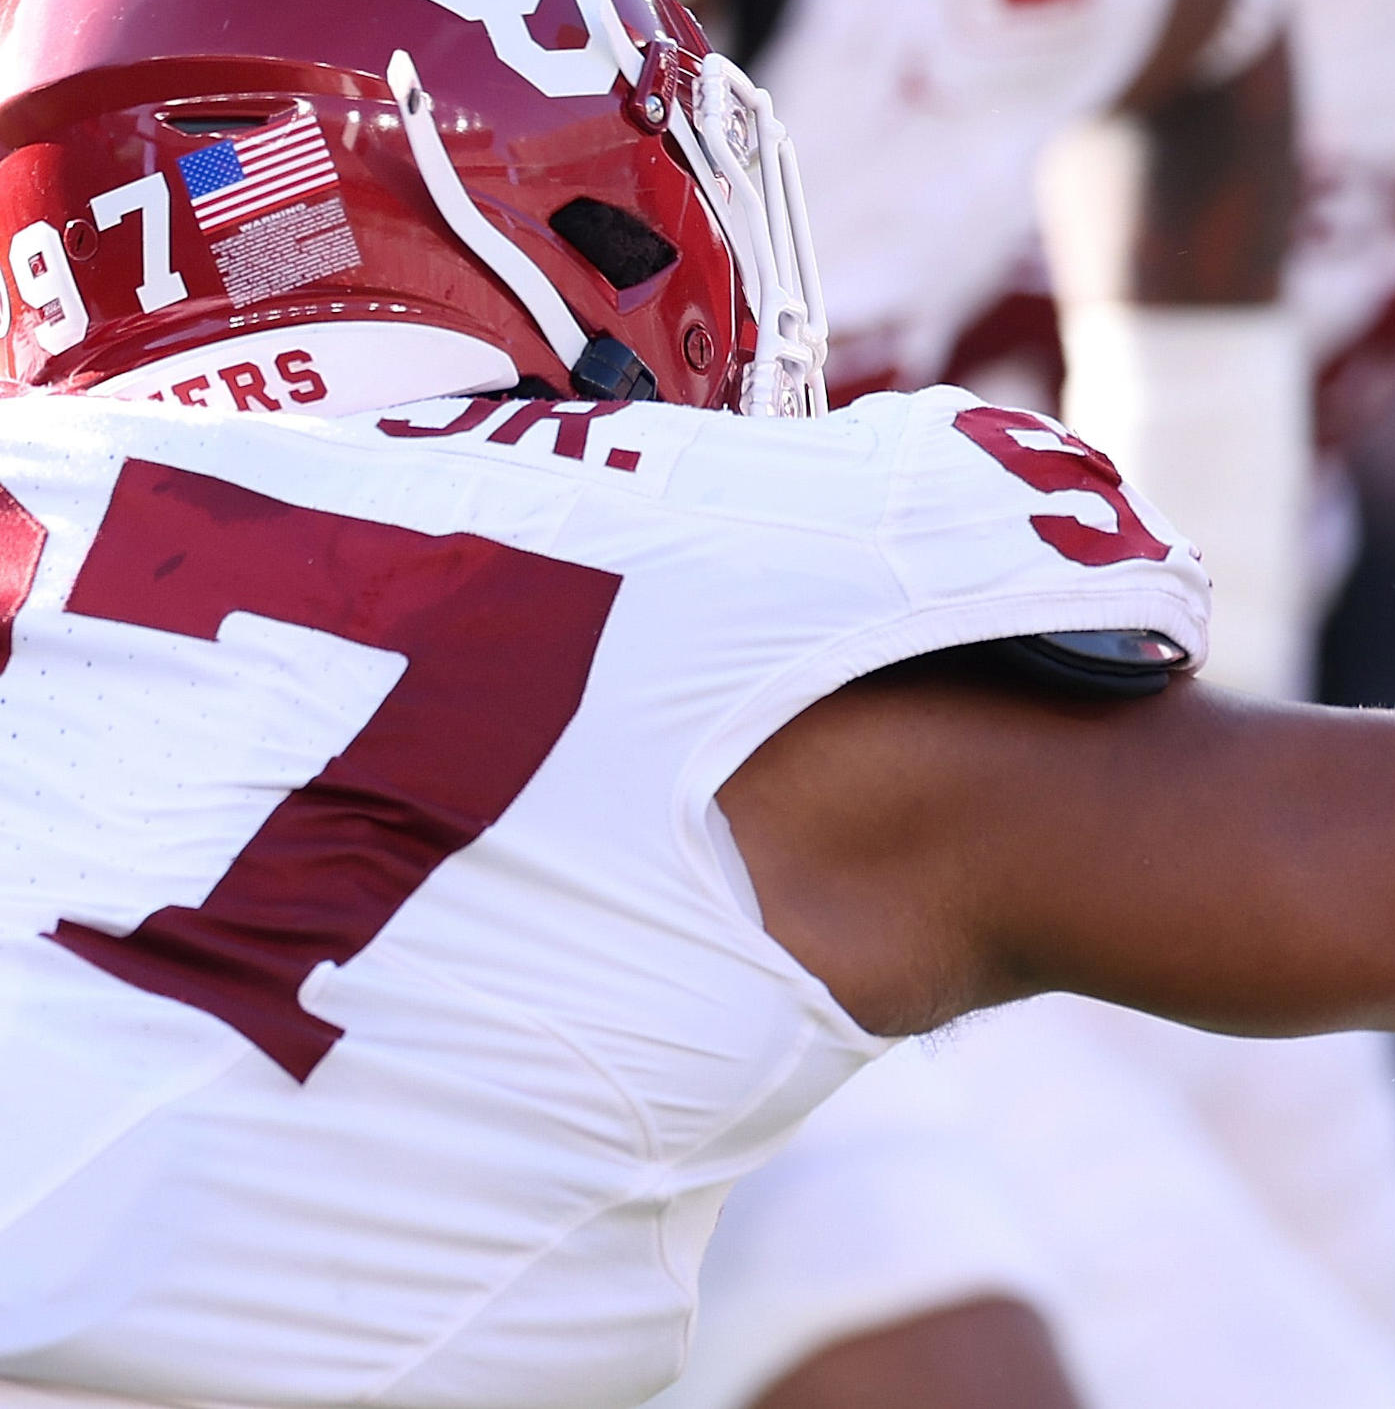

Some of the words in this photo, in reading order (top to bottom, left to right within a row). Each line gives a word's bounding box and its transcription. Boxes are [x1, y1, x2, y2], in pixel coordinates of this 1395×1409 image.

[8, 171, 189, 357] 97
[238, 202, 307, 233] WARNING
[147, 349, 328, 412] ERS
[0, 456, 623, 1087] 7
